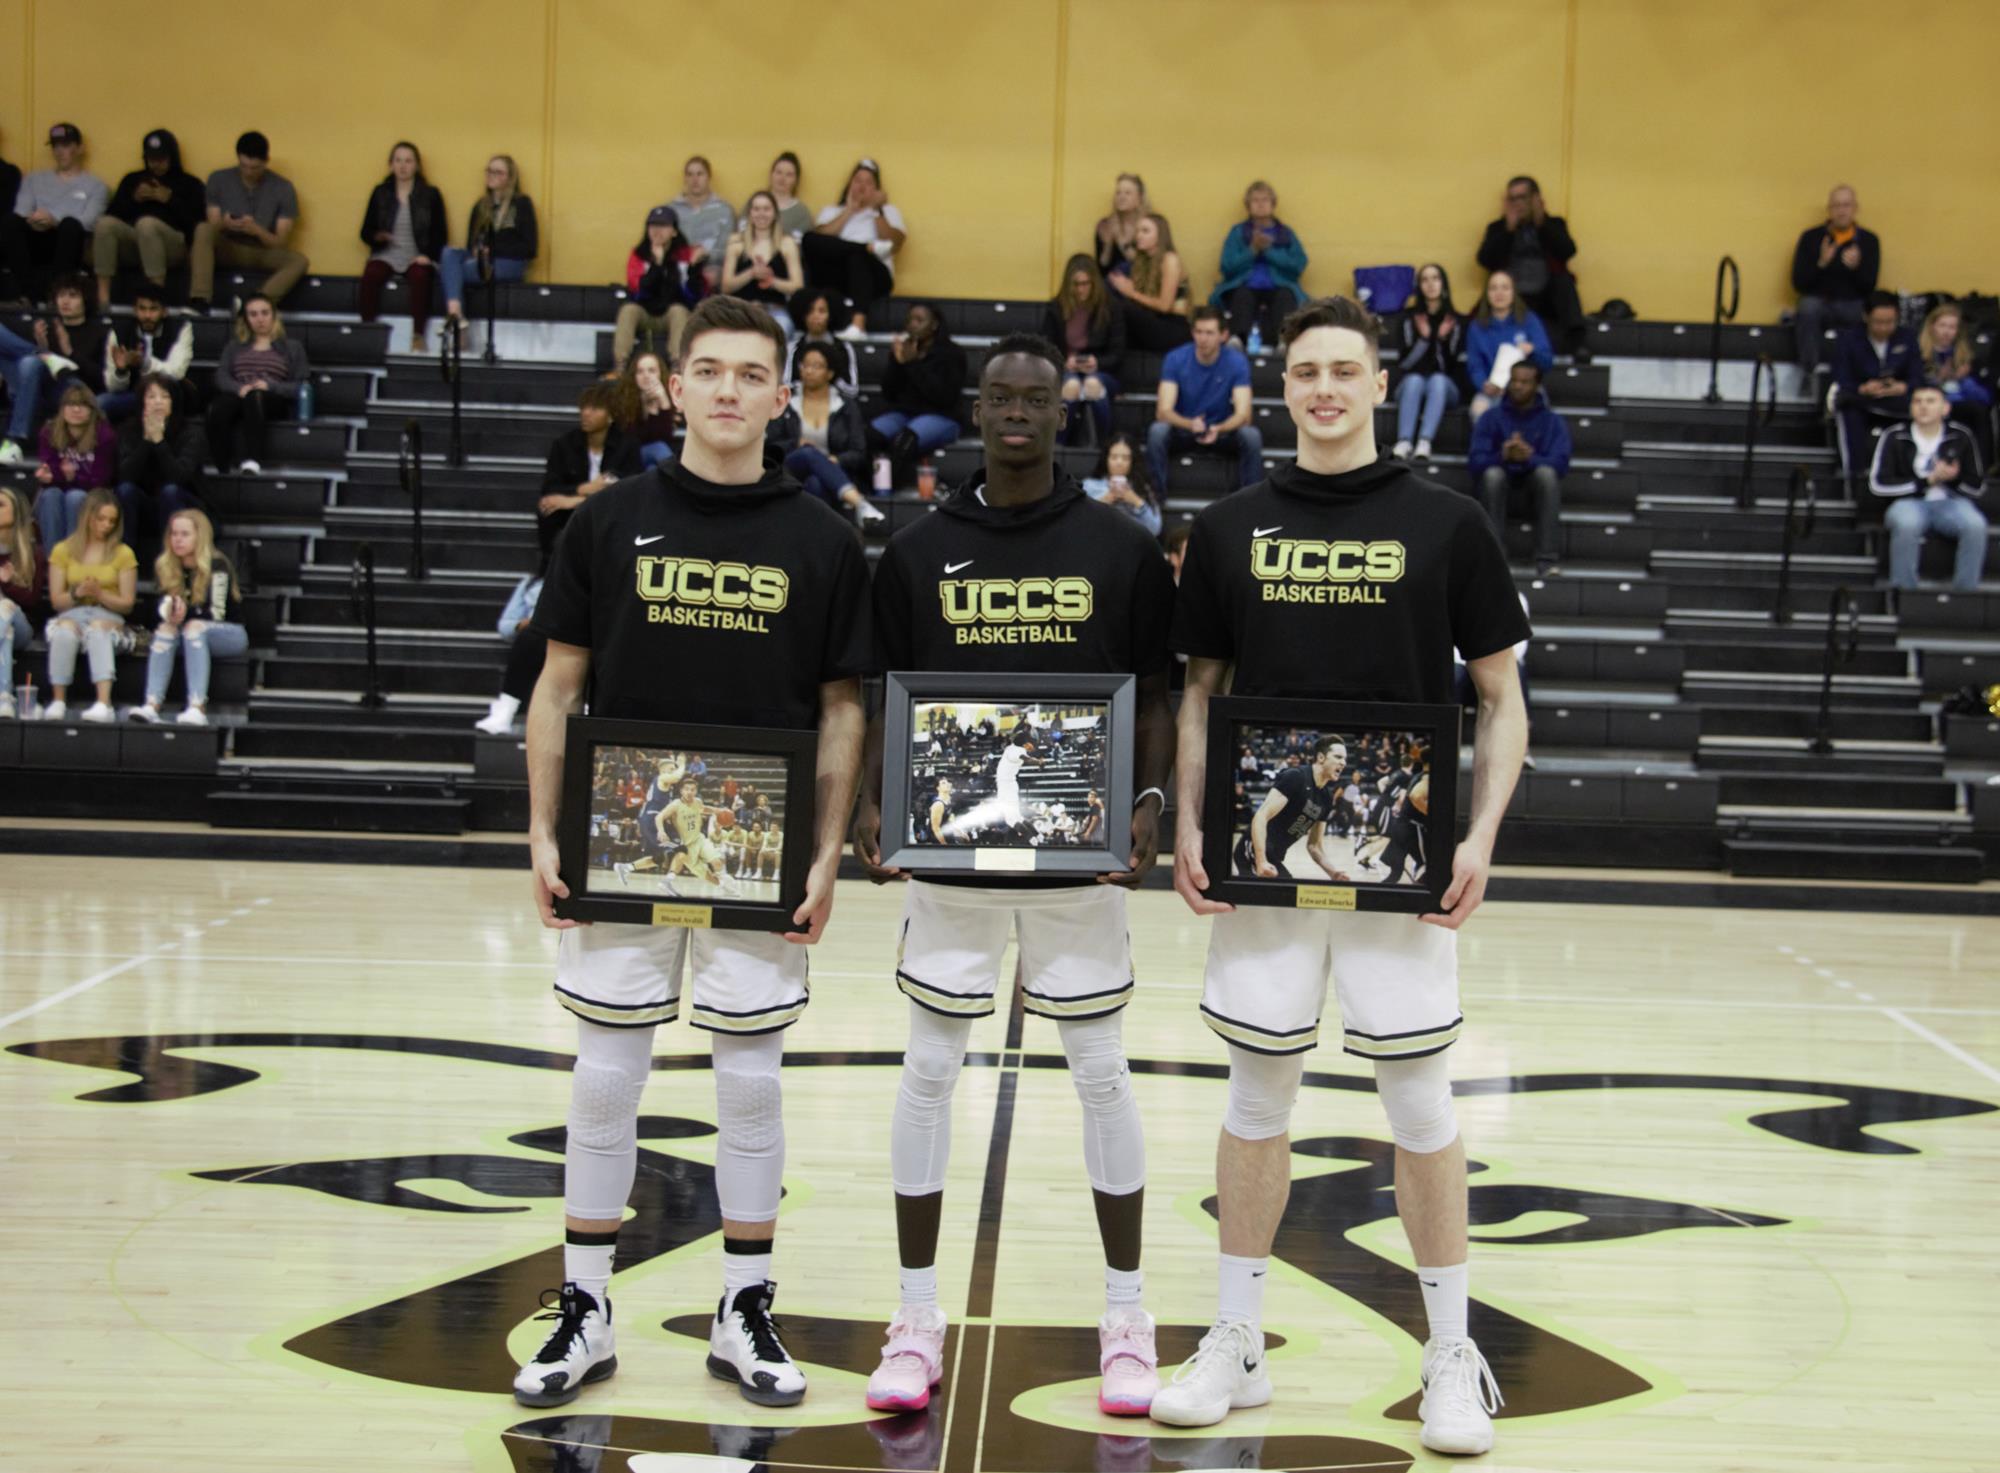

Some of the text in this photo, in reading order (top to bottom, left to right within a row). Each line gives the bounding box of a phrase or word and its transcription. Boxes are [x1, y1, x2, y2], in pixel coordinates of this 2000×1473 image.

[1251, 538, 1406, 582] UCCS
[636, 555, 790, 613] UCCS
[939, 577, 1093, 624] UCCS
[1262, 583, 1387, 604] BASKETBALL
[647, 605, 769, 633] BASKETBALL
[956, 625, 1078, 645] BASKETBALL
